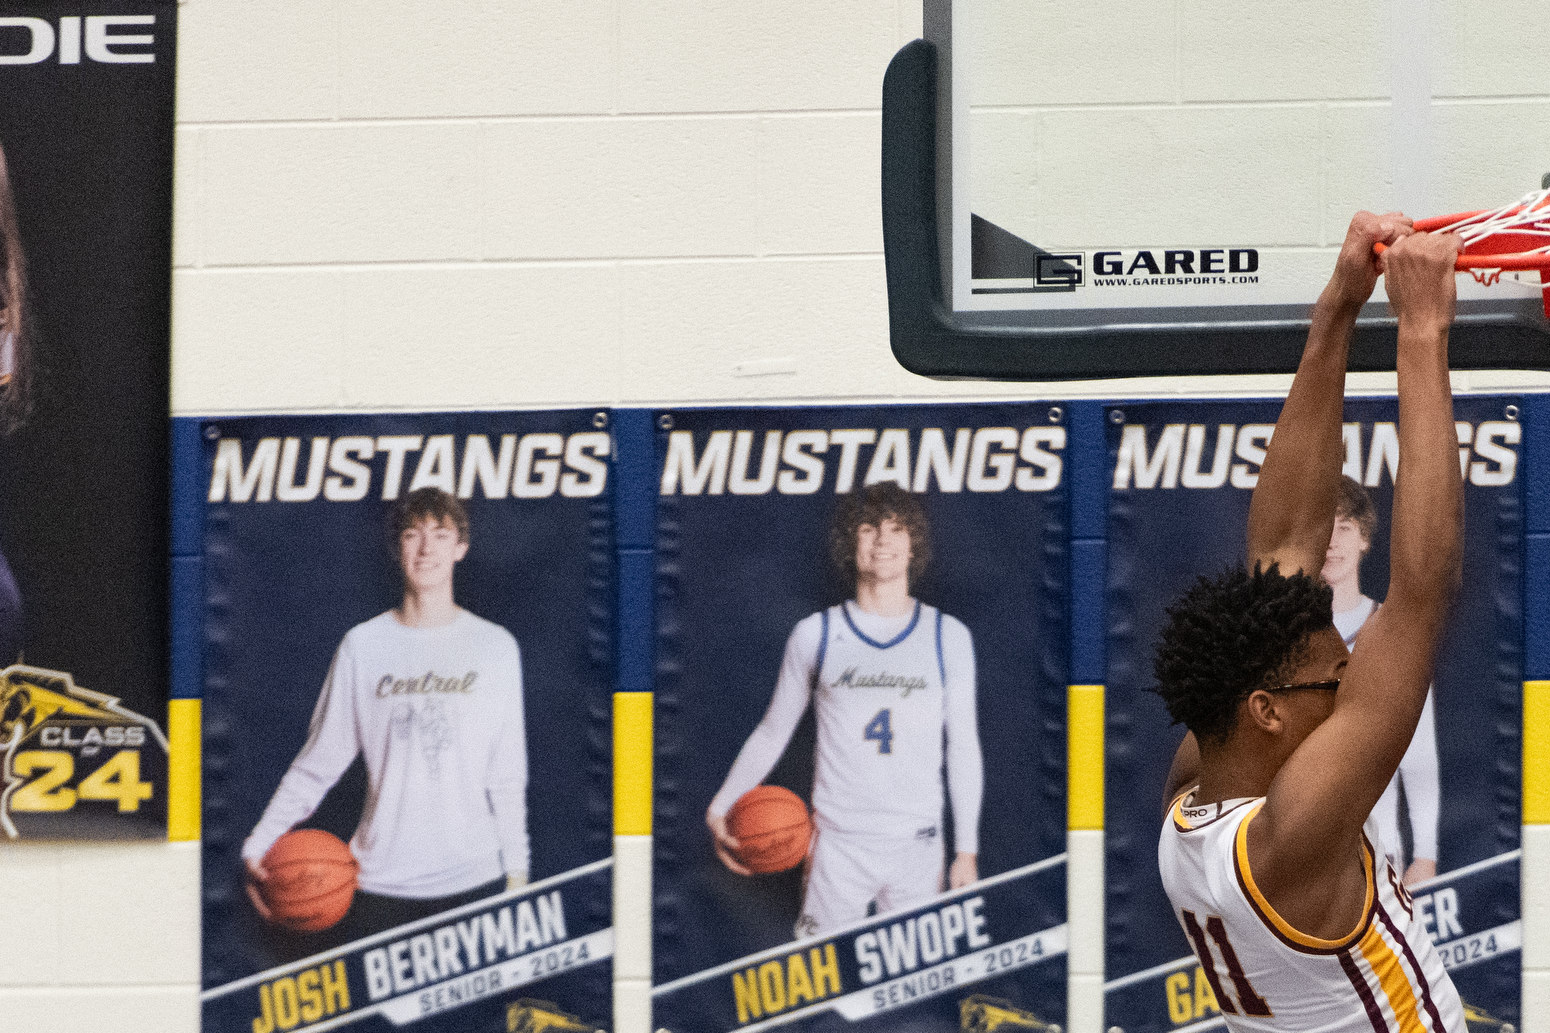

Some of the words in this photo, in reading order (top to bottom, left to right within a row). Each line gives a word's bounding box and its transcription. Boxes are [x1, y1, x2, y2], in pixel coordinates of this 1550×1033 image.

[1093, 249, 1259, 275] GARED
[1094, 275, 1259, 287] WWW.GAREDSPORTS.COM
[206, 431, 613, 504] MUSTANGS
[659, 426, 1067, 496] MUSTANGS
[375, 669, 479, 699] Central
[829, 664, 929, 699] Mustangs
[40, 726, 146, 747] CLASS
[862, 707, 894, 755] 4
[10, 748, 155, 813] 24
[1183, 808, 1208, 818] PRO
[363, 890, 567, 1001] BERRYMAN
[732, 943, 841, 1024] NOAH
[854, 895, 990, 984] SWOPE
[1180, 906, 1275, 1018] 11
[1438, 932, 1499, 969] 2024
[419, 967, 502, 1013] SENIOR
[531, 940, 591, 977] 2024
[873, 966, 956, 1010] SENIOR
[984, 938, 1045, 974] 2024
